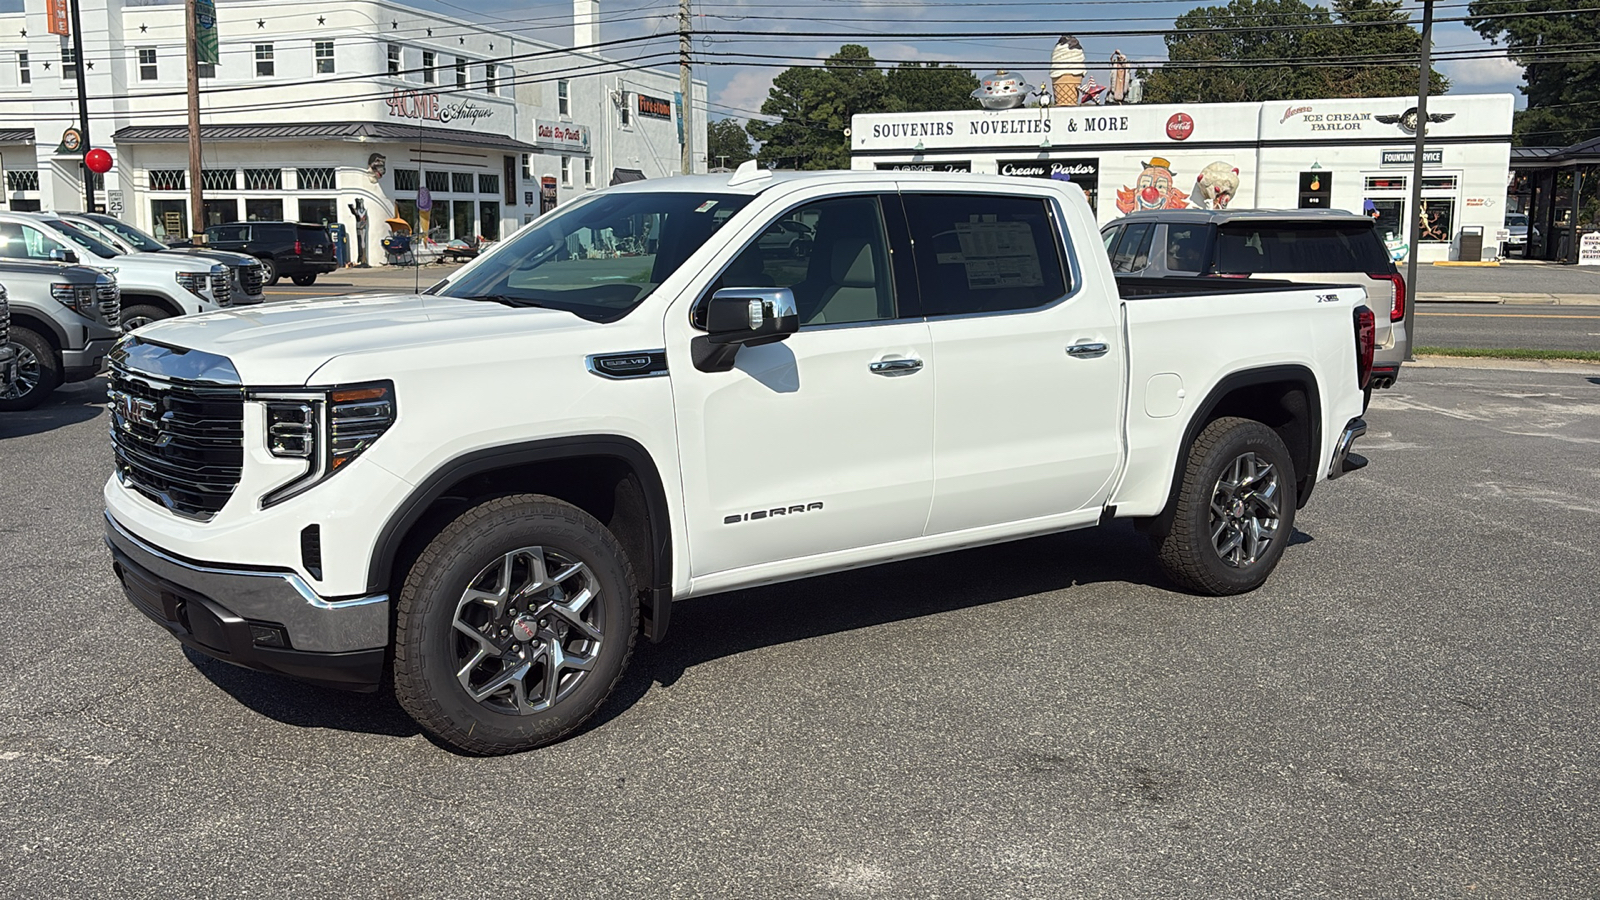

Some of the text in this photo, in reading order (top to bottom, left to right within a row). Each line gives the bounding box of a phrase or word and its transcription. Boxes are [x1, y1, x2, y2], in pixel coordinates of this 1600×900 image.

[386, 87, 440, 121] ACME
[452, 98, 494, 125] Antiques
[1303, 113, 1371, 122] ICE CREAM
[873, 117, 1129, 138] SOUVENIRS NOVELTIES & MORE
[1311, 123, 1361, 131] PARLOR
[554, 127, 564, 142] Boy
[1384, 153, 1440, 162] FOUNTAIN RVICE
[1001, 163, 1045, 176] Cream
[1050, 163, 1096, 175] Parlor
[110, 202, 123, 211] 25
[723, 501, 824, 525] SIERRA
